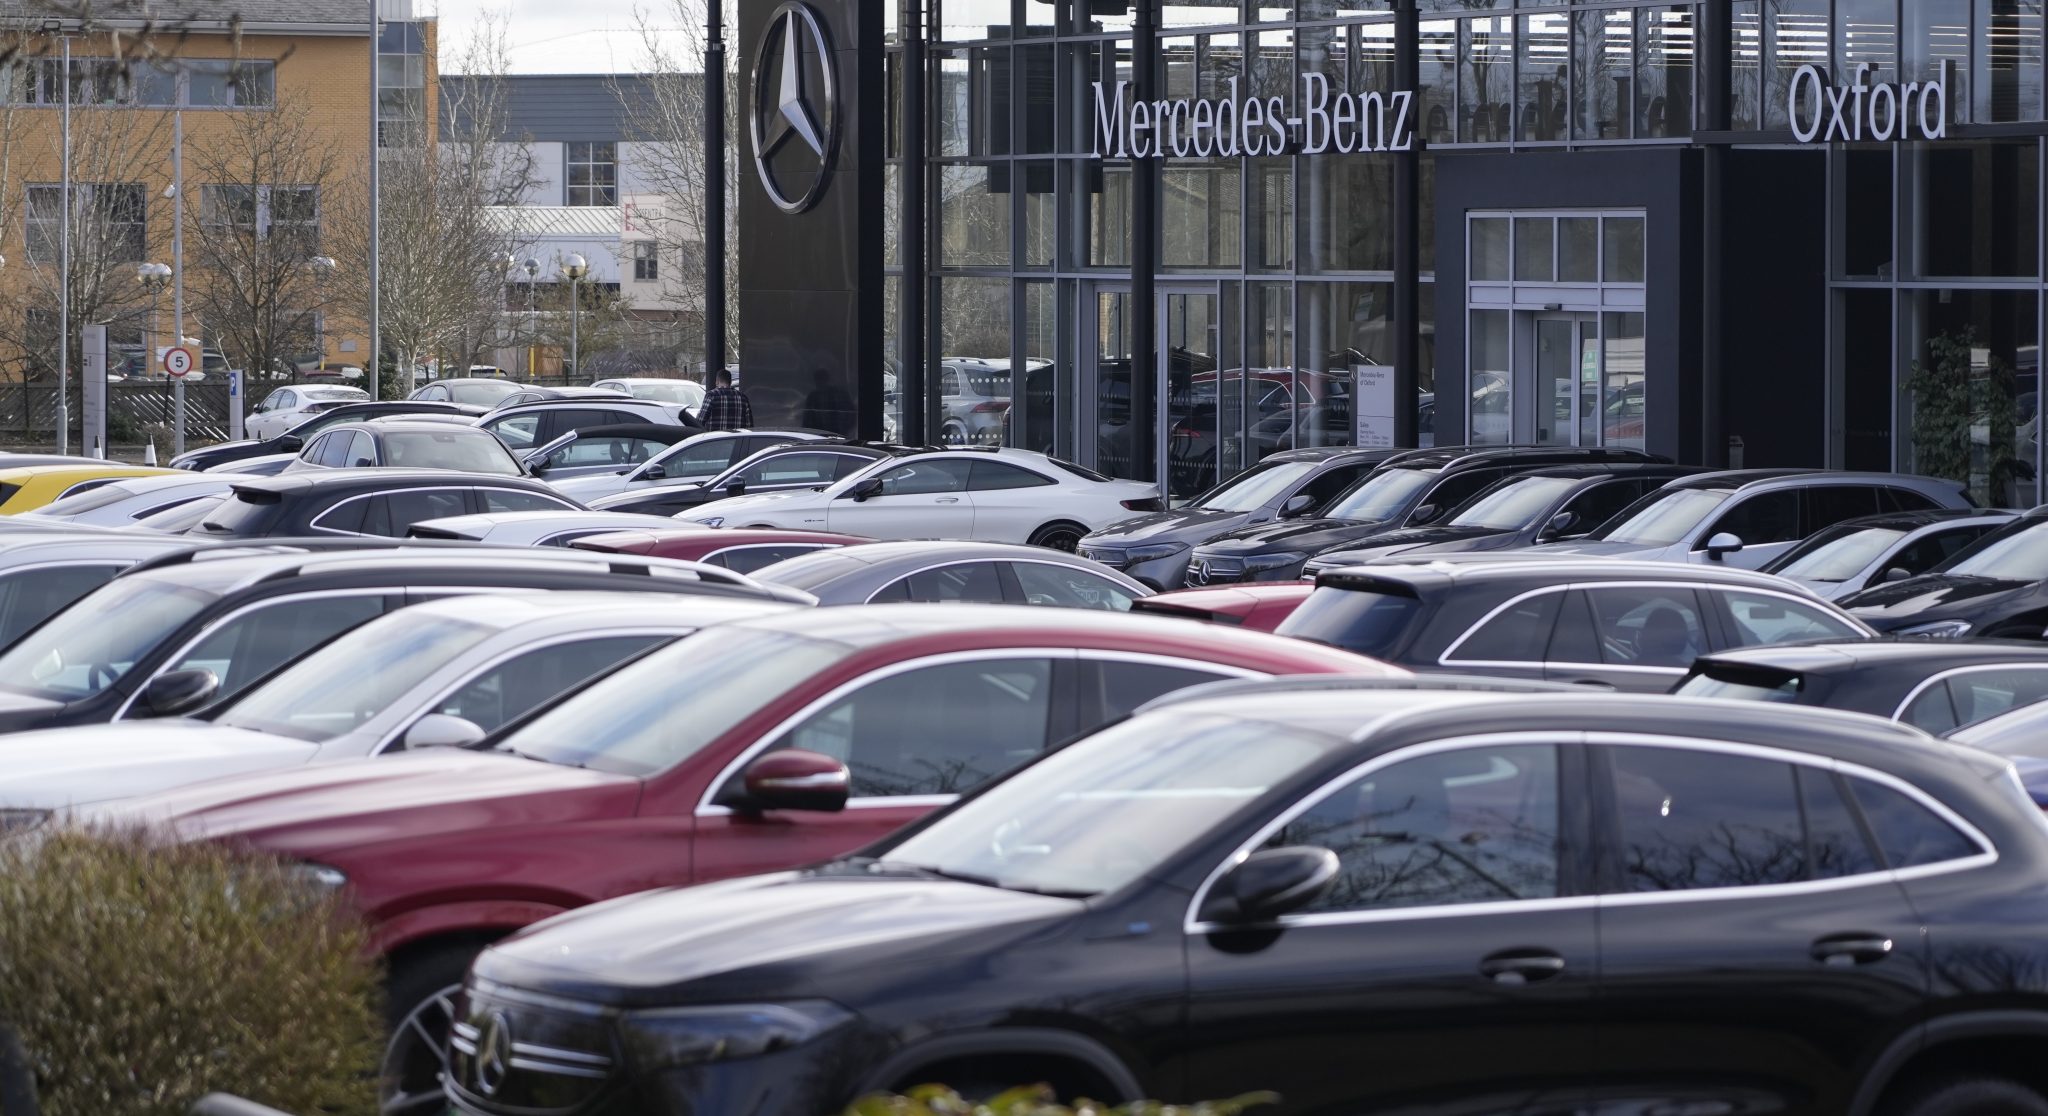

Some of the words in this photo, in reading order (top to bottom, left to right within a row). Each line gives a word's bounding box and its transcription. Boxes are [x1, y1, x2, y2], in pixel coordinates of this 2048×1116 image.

[1091, 71, 1413, 159] Mercedes-Benz
[1789, 58, 1947, 143] Oxford
[175, 356, 184, 368] 5
